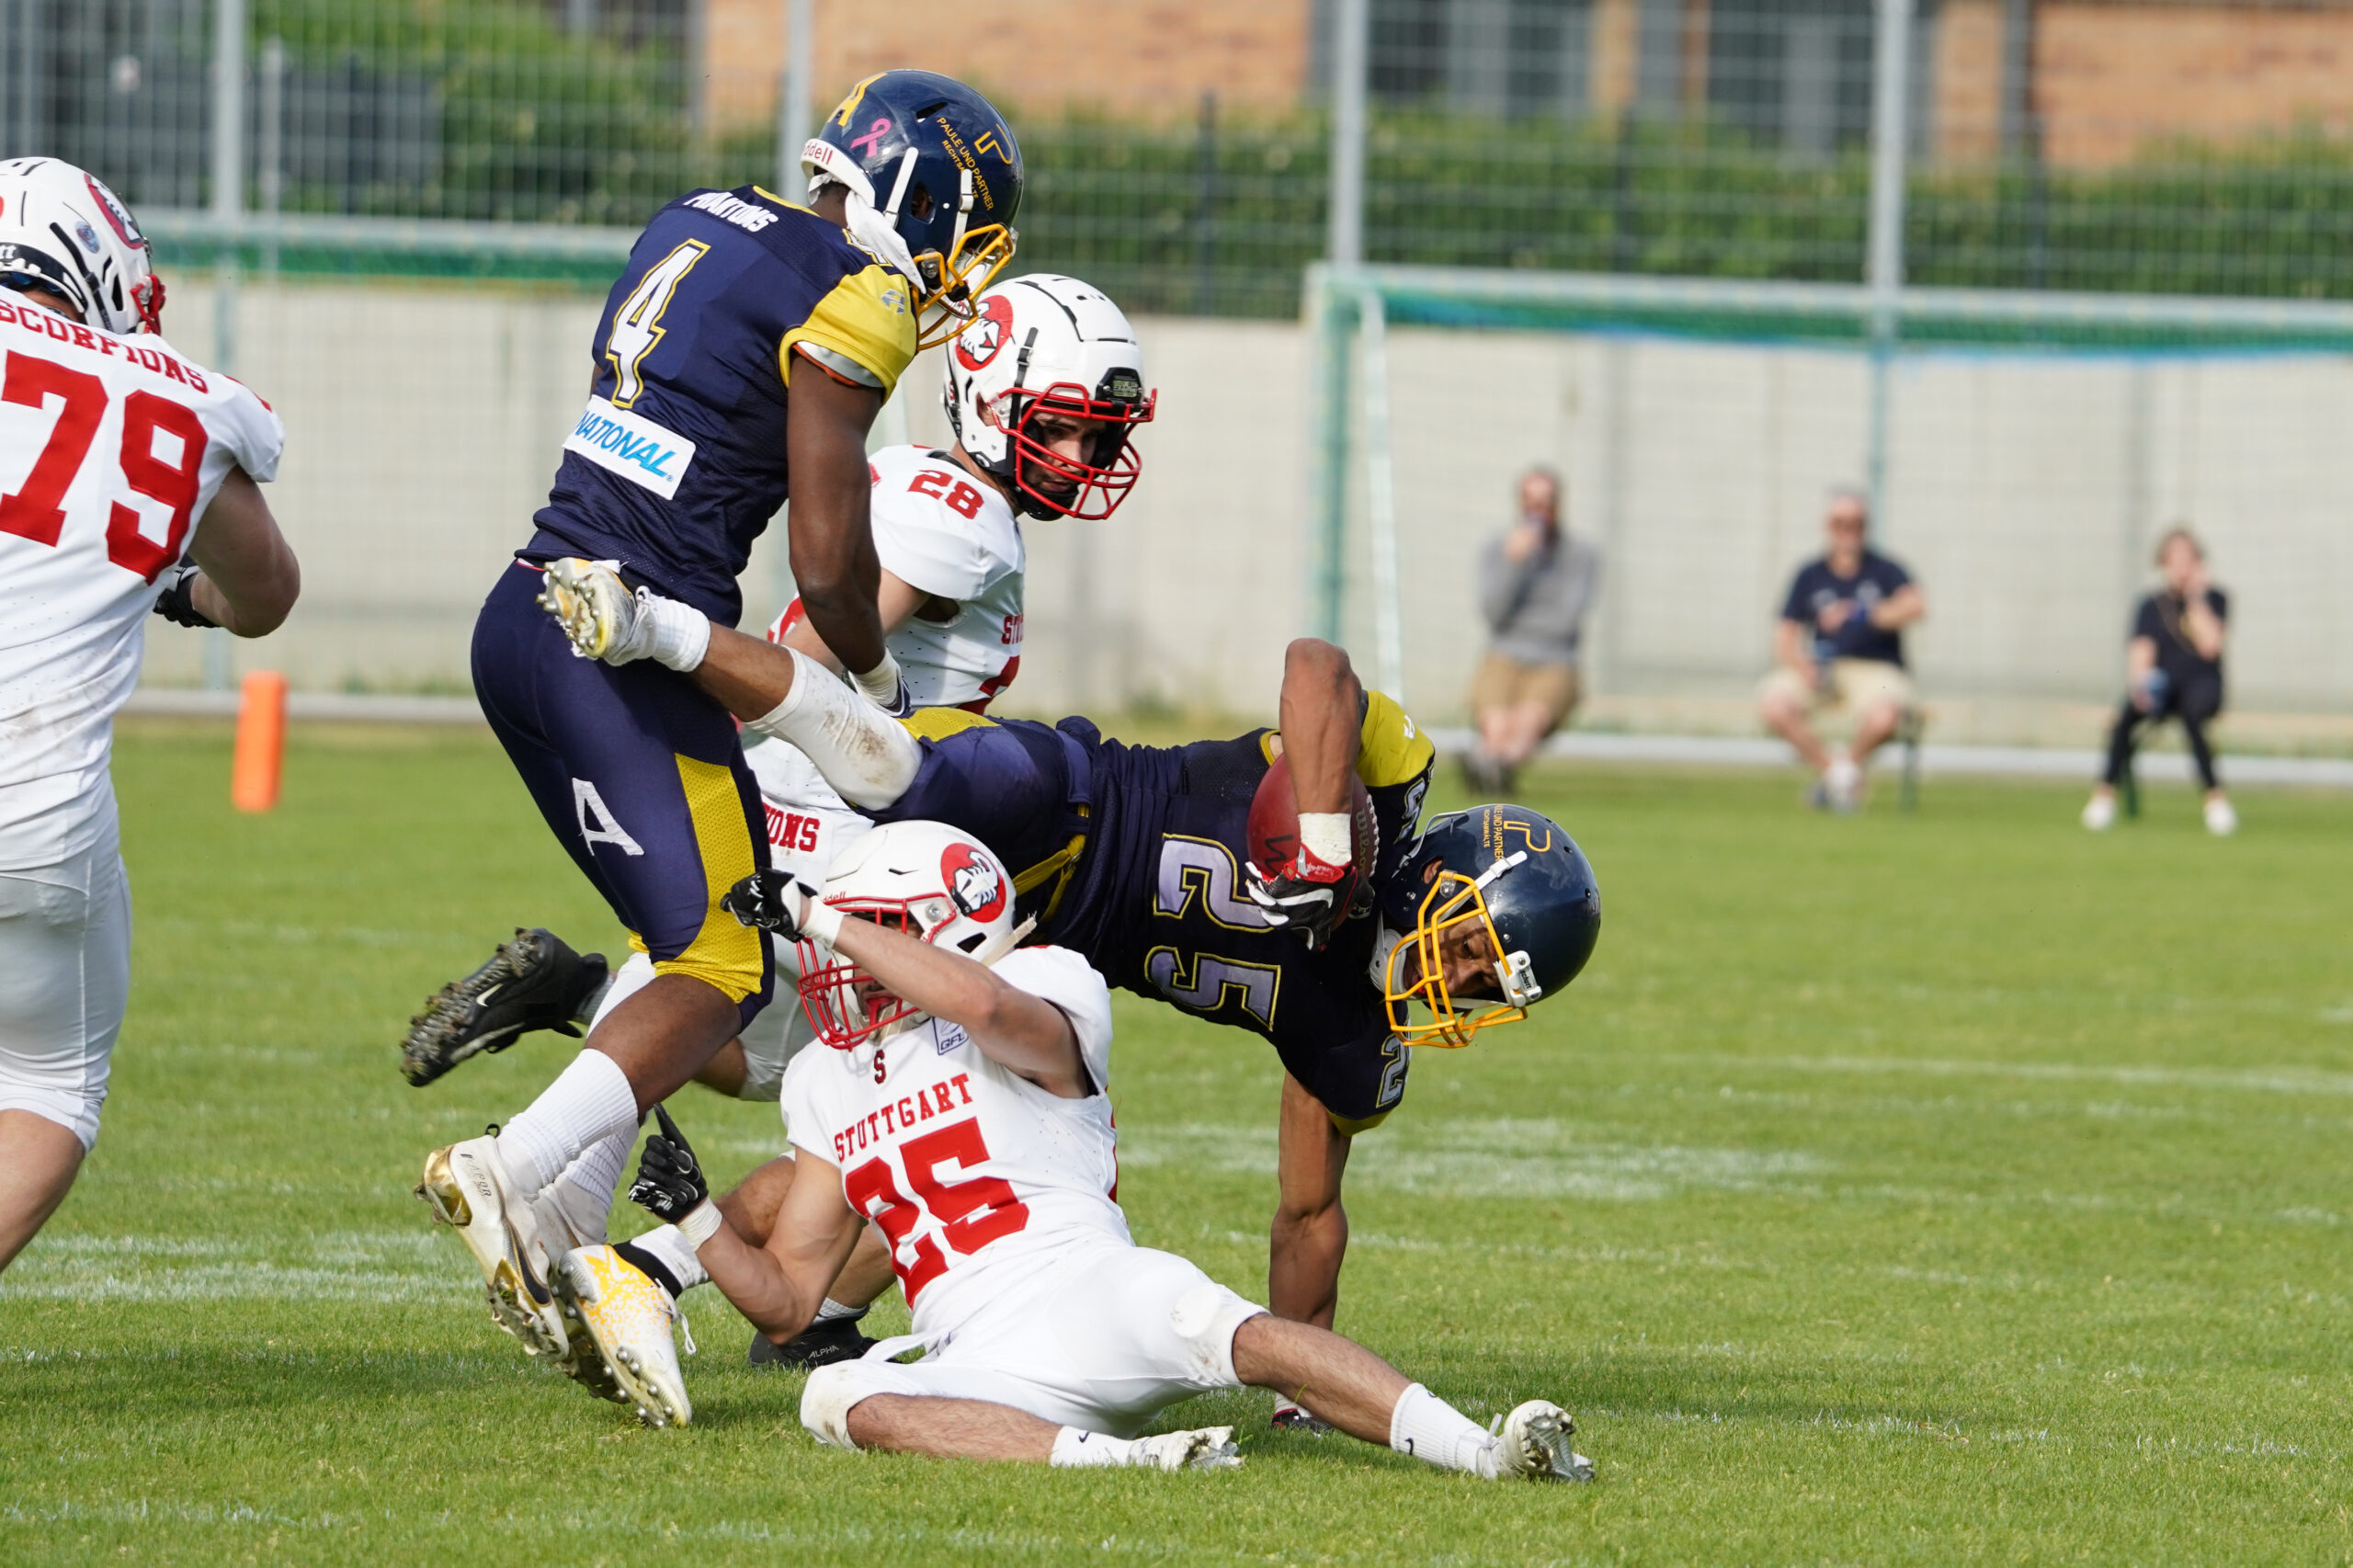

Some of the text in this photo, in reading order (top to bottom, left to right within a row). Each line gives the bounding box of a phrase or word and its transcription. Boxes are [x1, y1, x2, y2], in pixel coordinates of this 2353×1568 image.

[937, 117, 995, 210] PAULE UND PARTNER
[0, 299, 210, 394] SCORPIONS
[606, 238, 711, 409] 4
[0, 349, 210, 586] 79
[575, 410, 676, 479] NATIONAL
[907, 469, 984, 519] 28
[573, 778, 644, 856] A
[1144, 833, 1281, 1031] 25
[874, 1049, 886, 1085] S
[940, 1033, 965, 1051] GFL
[835, 1073, 973, 1162] STUTTGART
[846, 1116, 1029, 1310] 25
[809, 1345, 839, 1359] ALPHA
